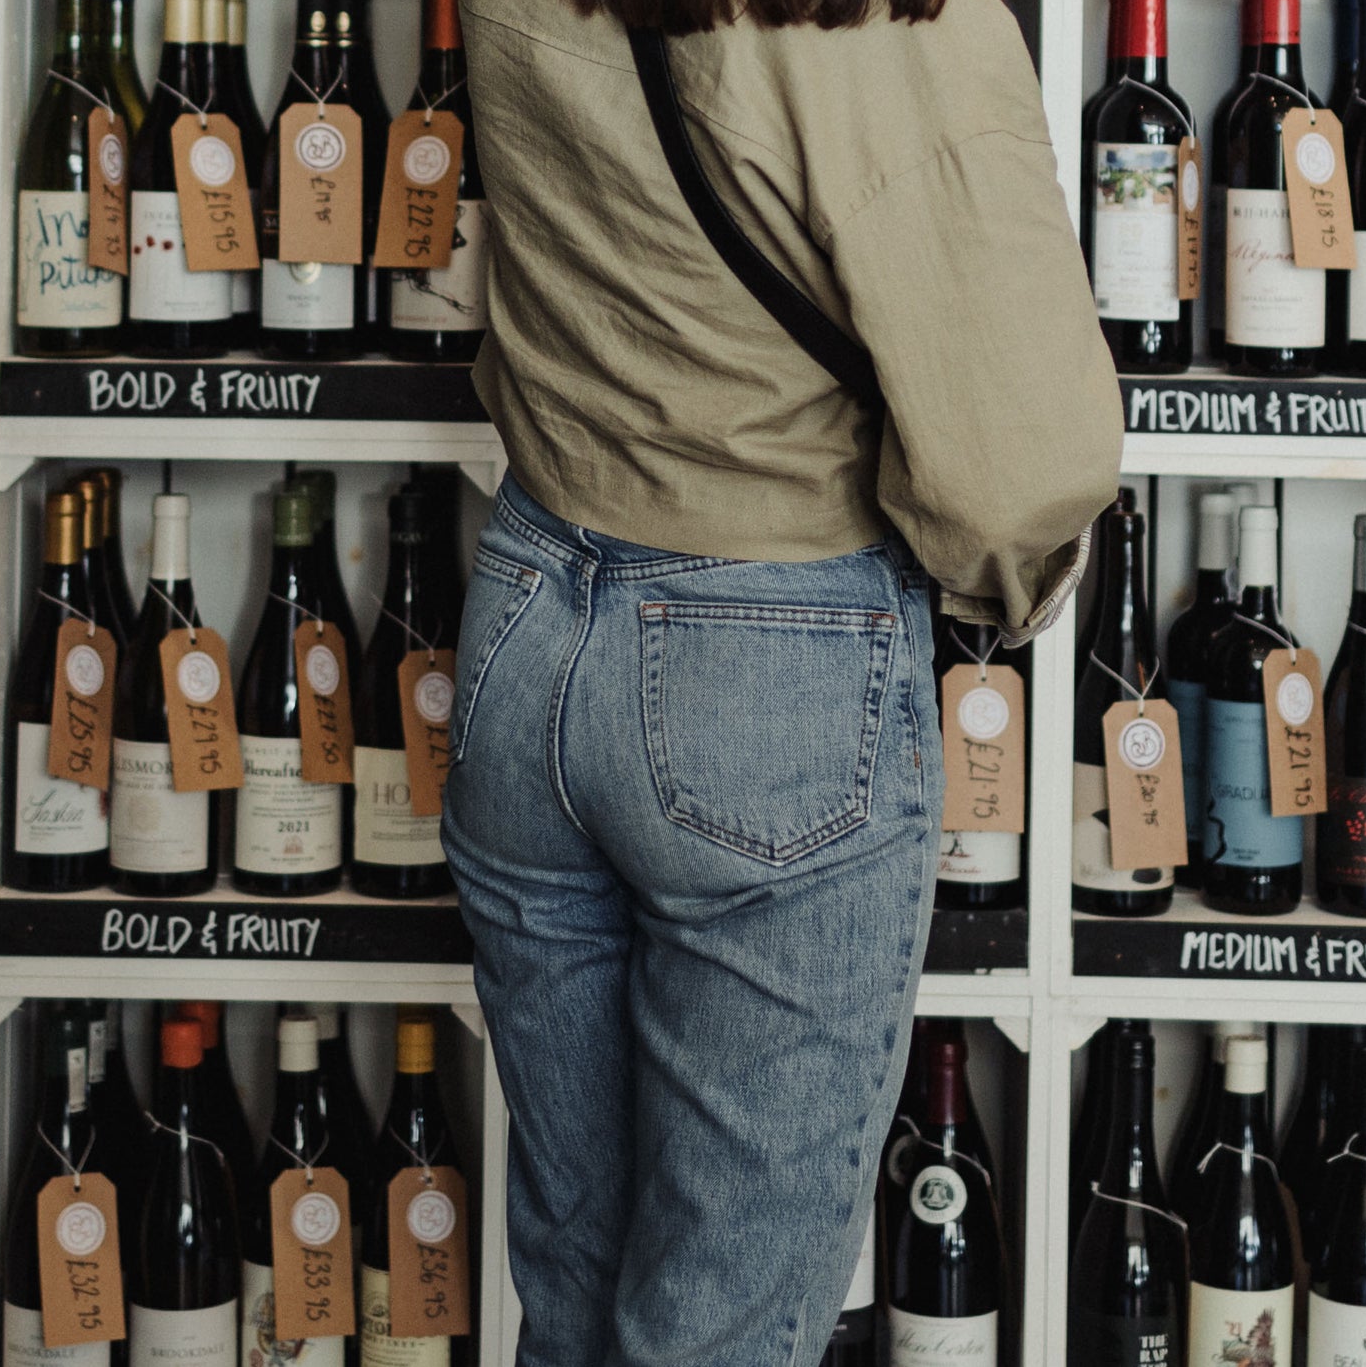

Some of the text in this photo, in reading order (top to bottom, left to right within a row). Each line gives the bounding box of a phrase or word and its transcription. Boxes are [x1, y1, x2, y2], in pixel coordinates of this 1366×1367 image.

[88, 363, 320, 420] BOLD & FRUITY
[1127, 388, 1259, 436] MEDIUM
[1264, 392, 1283, 437] &
[102, 909, 320, 961] BOLD & FRUITY
[1181, 932, 1297, 973] MEDIUM
[1305, 936, 1320, 976] &
